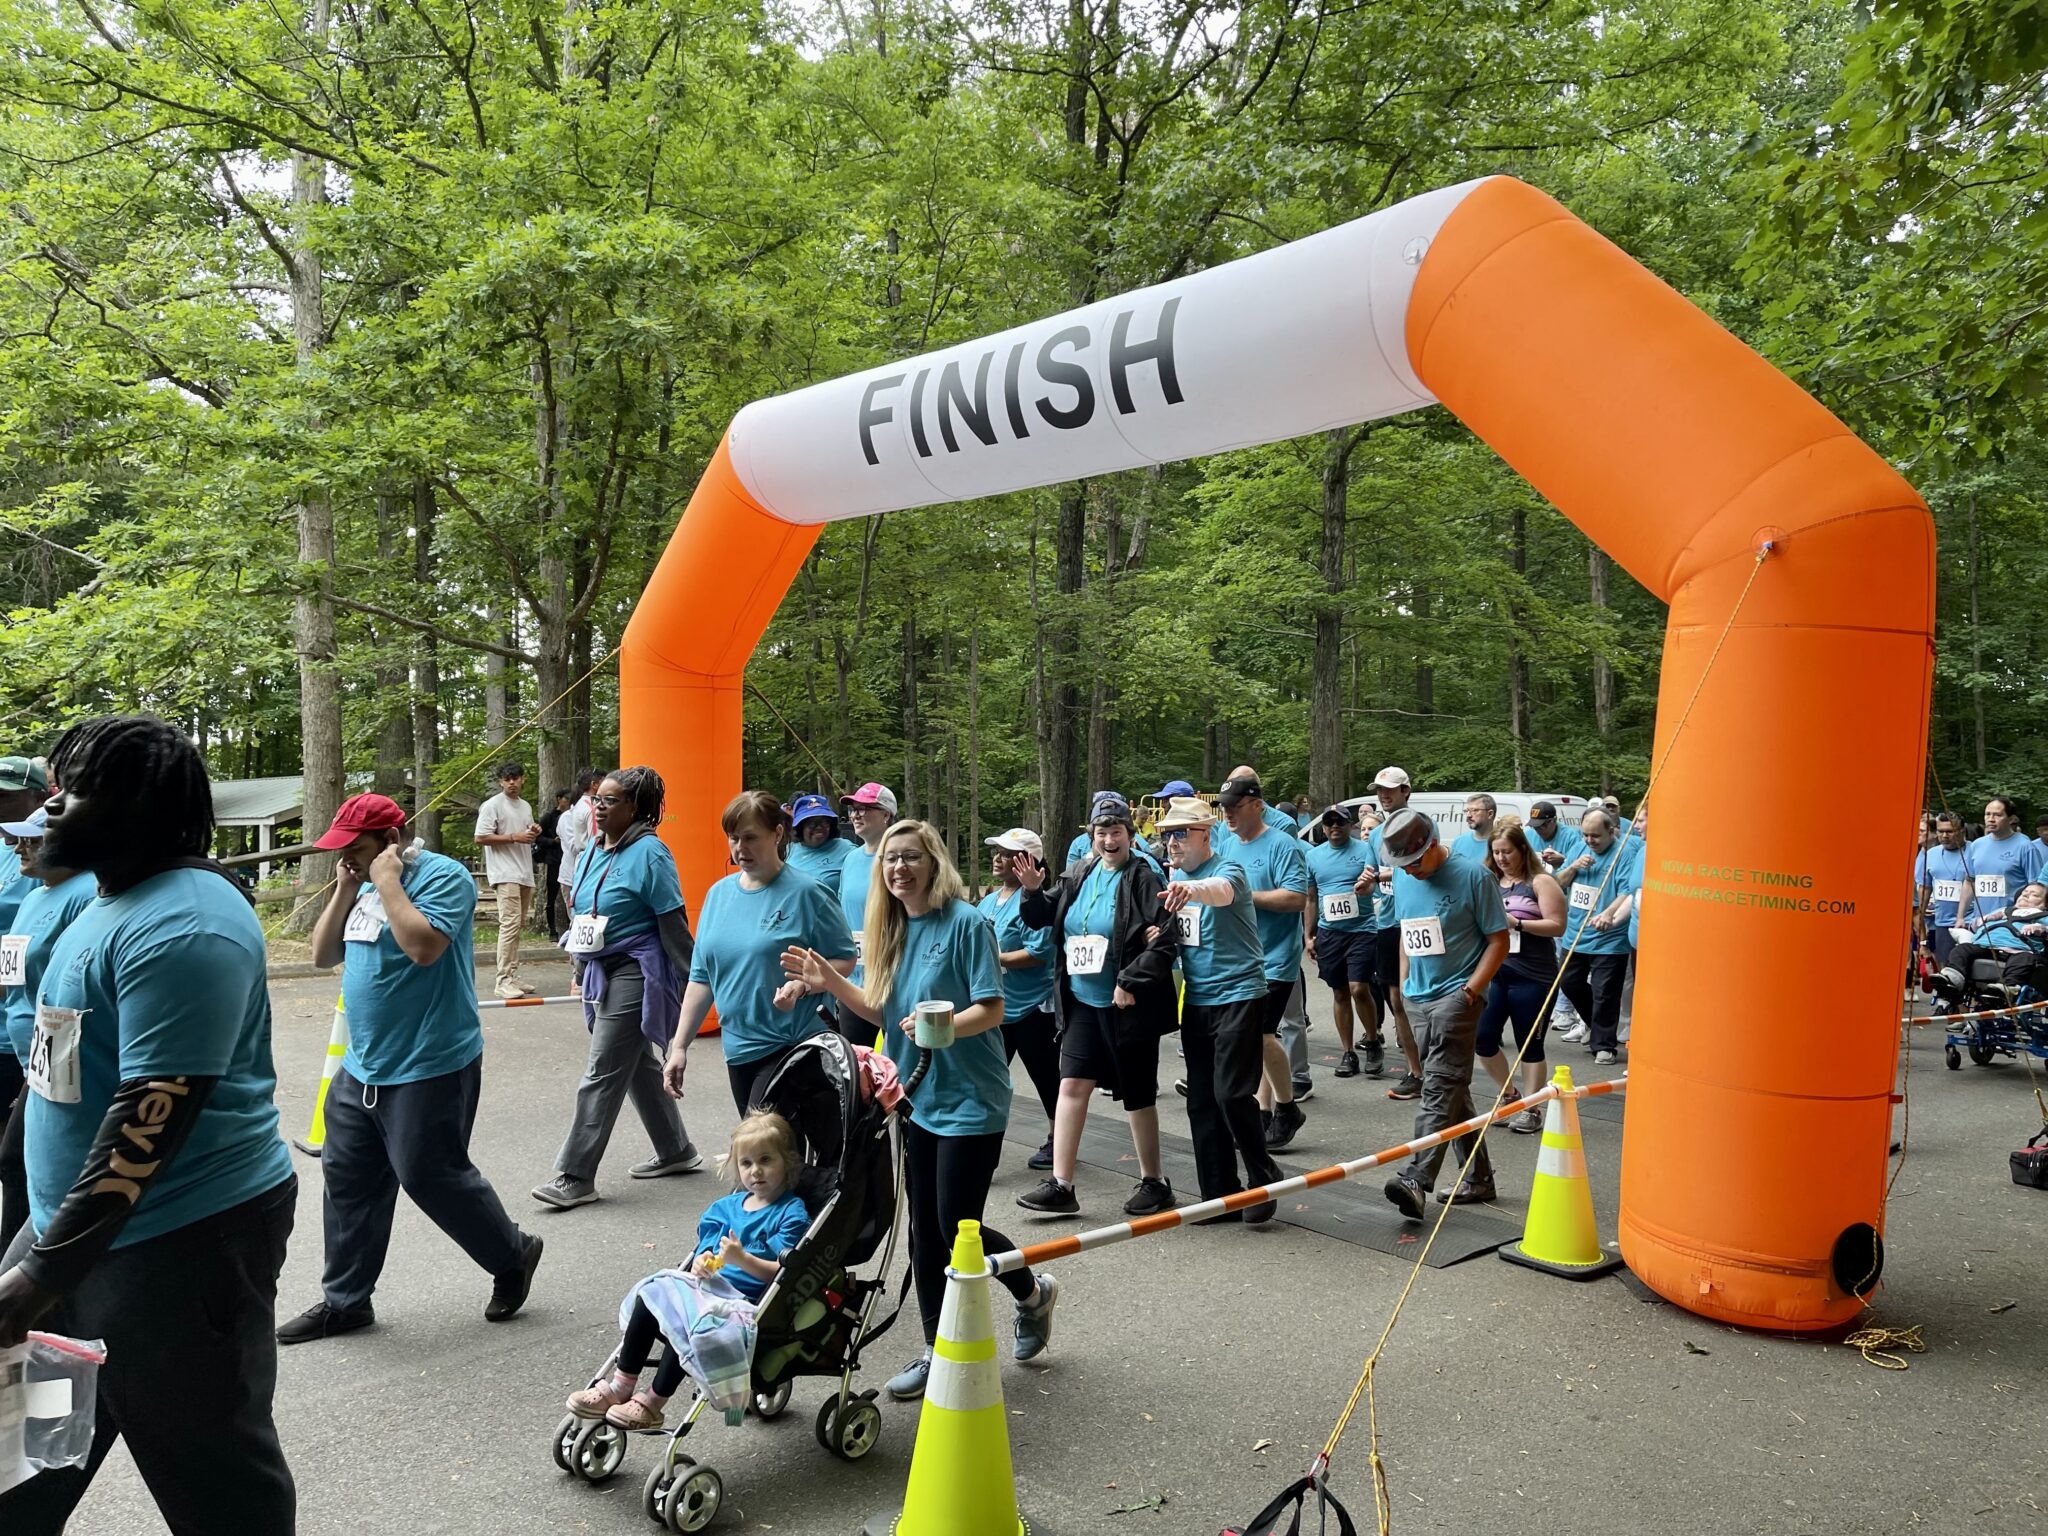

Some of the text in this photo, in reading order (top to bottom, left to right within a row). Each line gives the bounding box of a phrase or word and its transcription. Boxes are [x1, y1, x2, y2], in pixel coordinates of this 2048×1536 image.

[859, 296, 1185, 466] FINISH
[1661, 859, 1814, 889] NOVA RACE TIMING
[1573, 890, 1590, 906] 398
[1938, 886, 1955, 898] 317
[1979, 882, 1998, 894] 318
[1329, 900, 1351, 916] 446
[576, 926, 594, 946] 358
[1405, 928, 1432, 950] 336
[1073, 945, 1094, 967] 334
